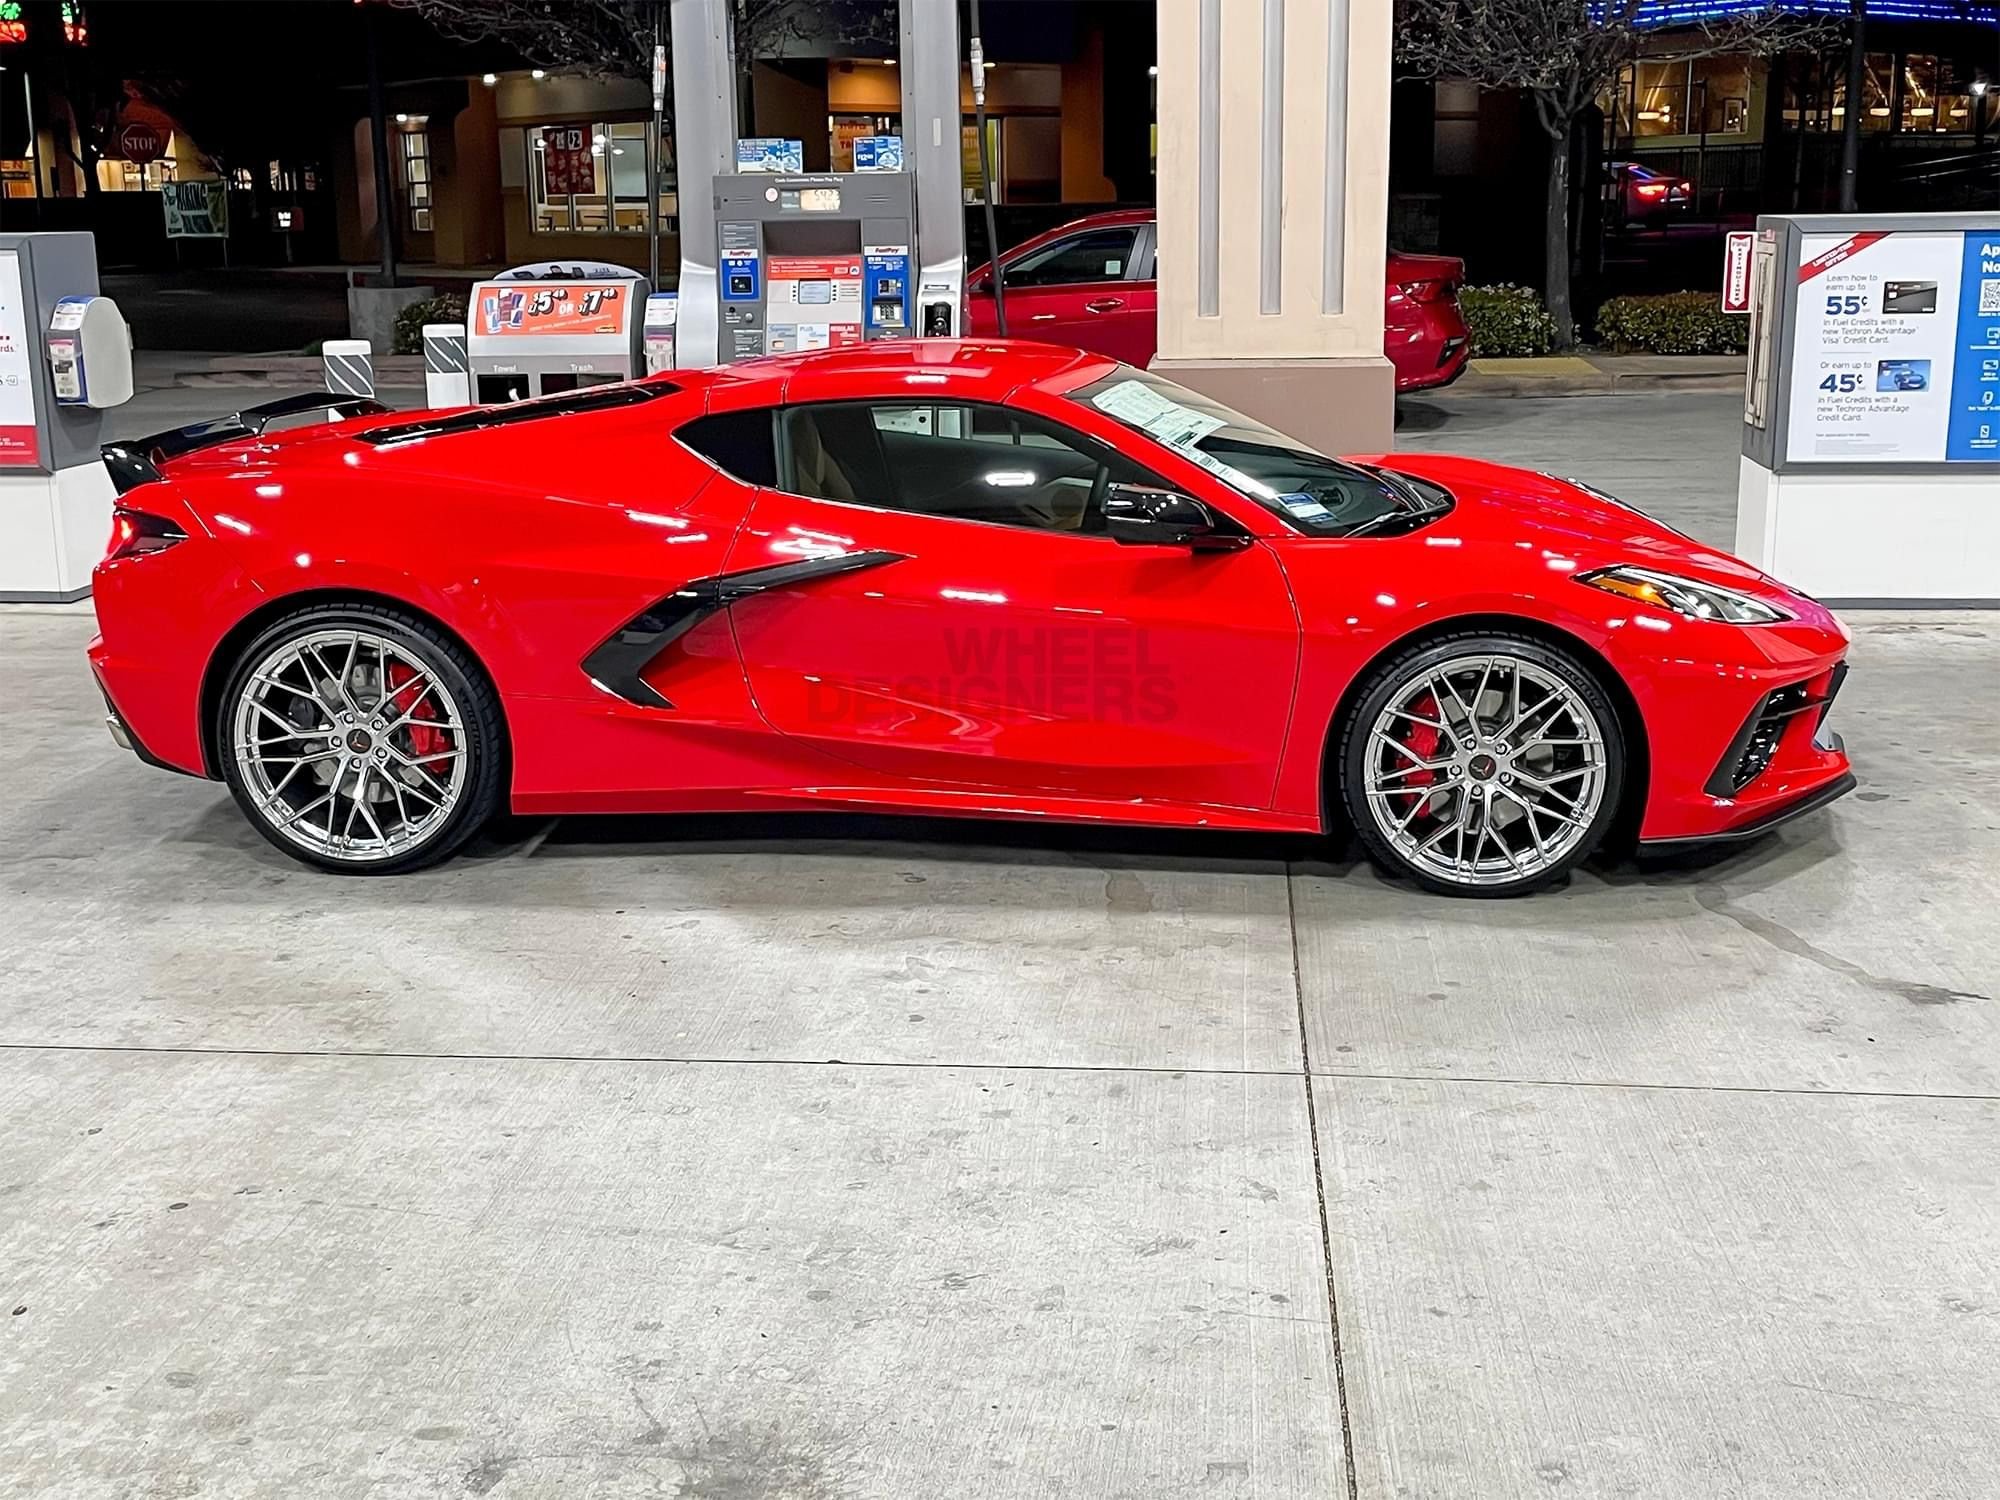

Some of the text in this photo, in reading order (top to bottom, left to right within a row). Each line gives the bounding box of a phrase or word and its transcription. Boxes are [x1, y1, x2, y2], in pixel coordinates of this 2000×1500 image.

[124, 137, 156, 150] STOP
[1826, 274, 1850, 282] Learn
[1851, 274, 1867, 282] how
[1841, 327, 1872, 335] Techron
[1843, 336, 1867, 344] Credit
[570, 363, 593, 373] Trash
[1820, 361, 1829, 369] Or
[1852, 362, 1862, 370] up
[1863, 361, 1872, 369] to
[1868, 405, 1910, 413] Advantage
